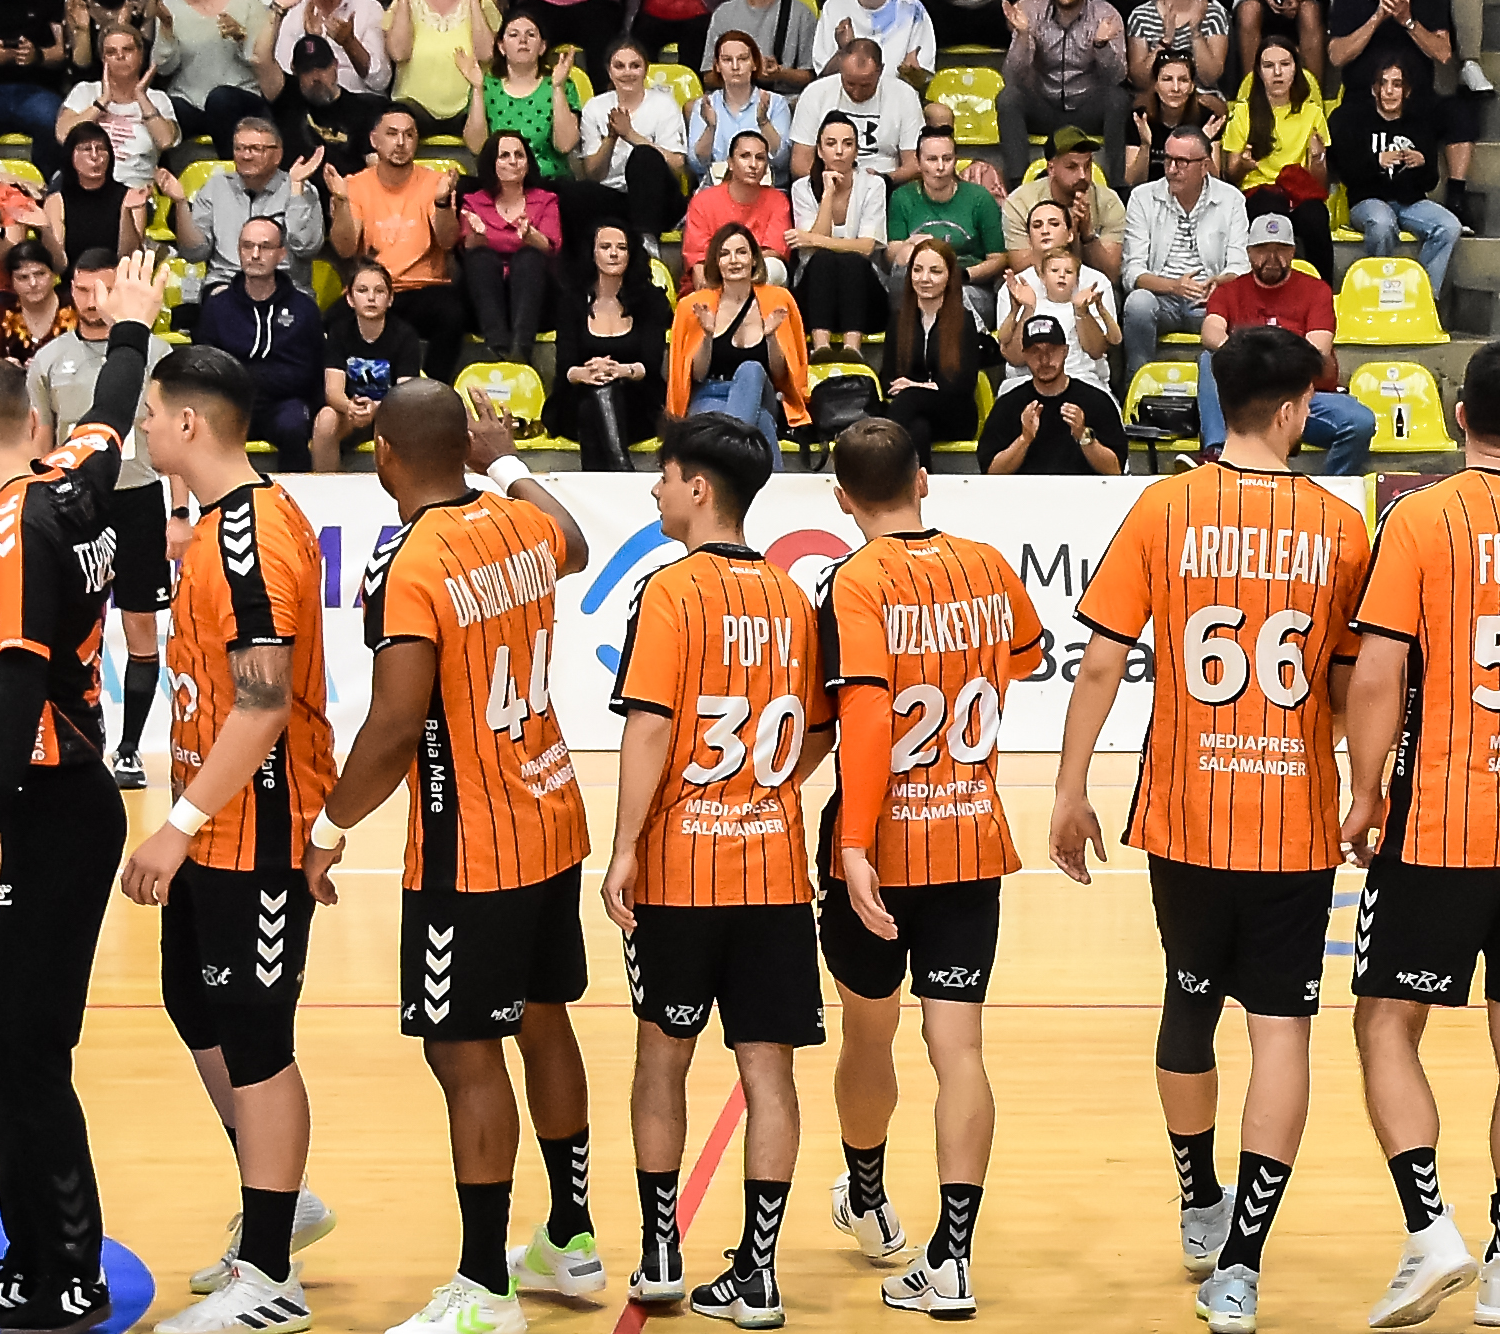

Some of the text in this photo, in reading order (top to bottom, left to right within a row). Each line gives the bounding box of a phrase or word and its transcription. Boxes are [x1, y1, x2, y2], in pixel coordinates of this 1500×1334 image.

[1179, 525, 1331, 586] ARDELEAN
[444, 574, 481, 628] DA
[723, 615, 799, 667] POP V.
[1184, 605, 1314, 709] 66
[682, 694, 805, 787] 30
[890, 676, 1000, 775] 20
[1199, 732, 1306, 753] MEDIAPRESS
[424, 718, 447, 815] Baia Mare
[1198, 755, 1307, 777] SALAMANDER
[1396, 731, 1413, 778] Mare
[891, 779, 988, 798] MEDIAPRESS
[891, 799, 993, 820] SALAMANDER
[681, 819, 785, 836] SALAMANDER
